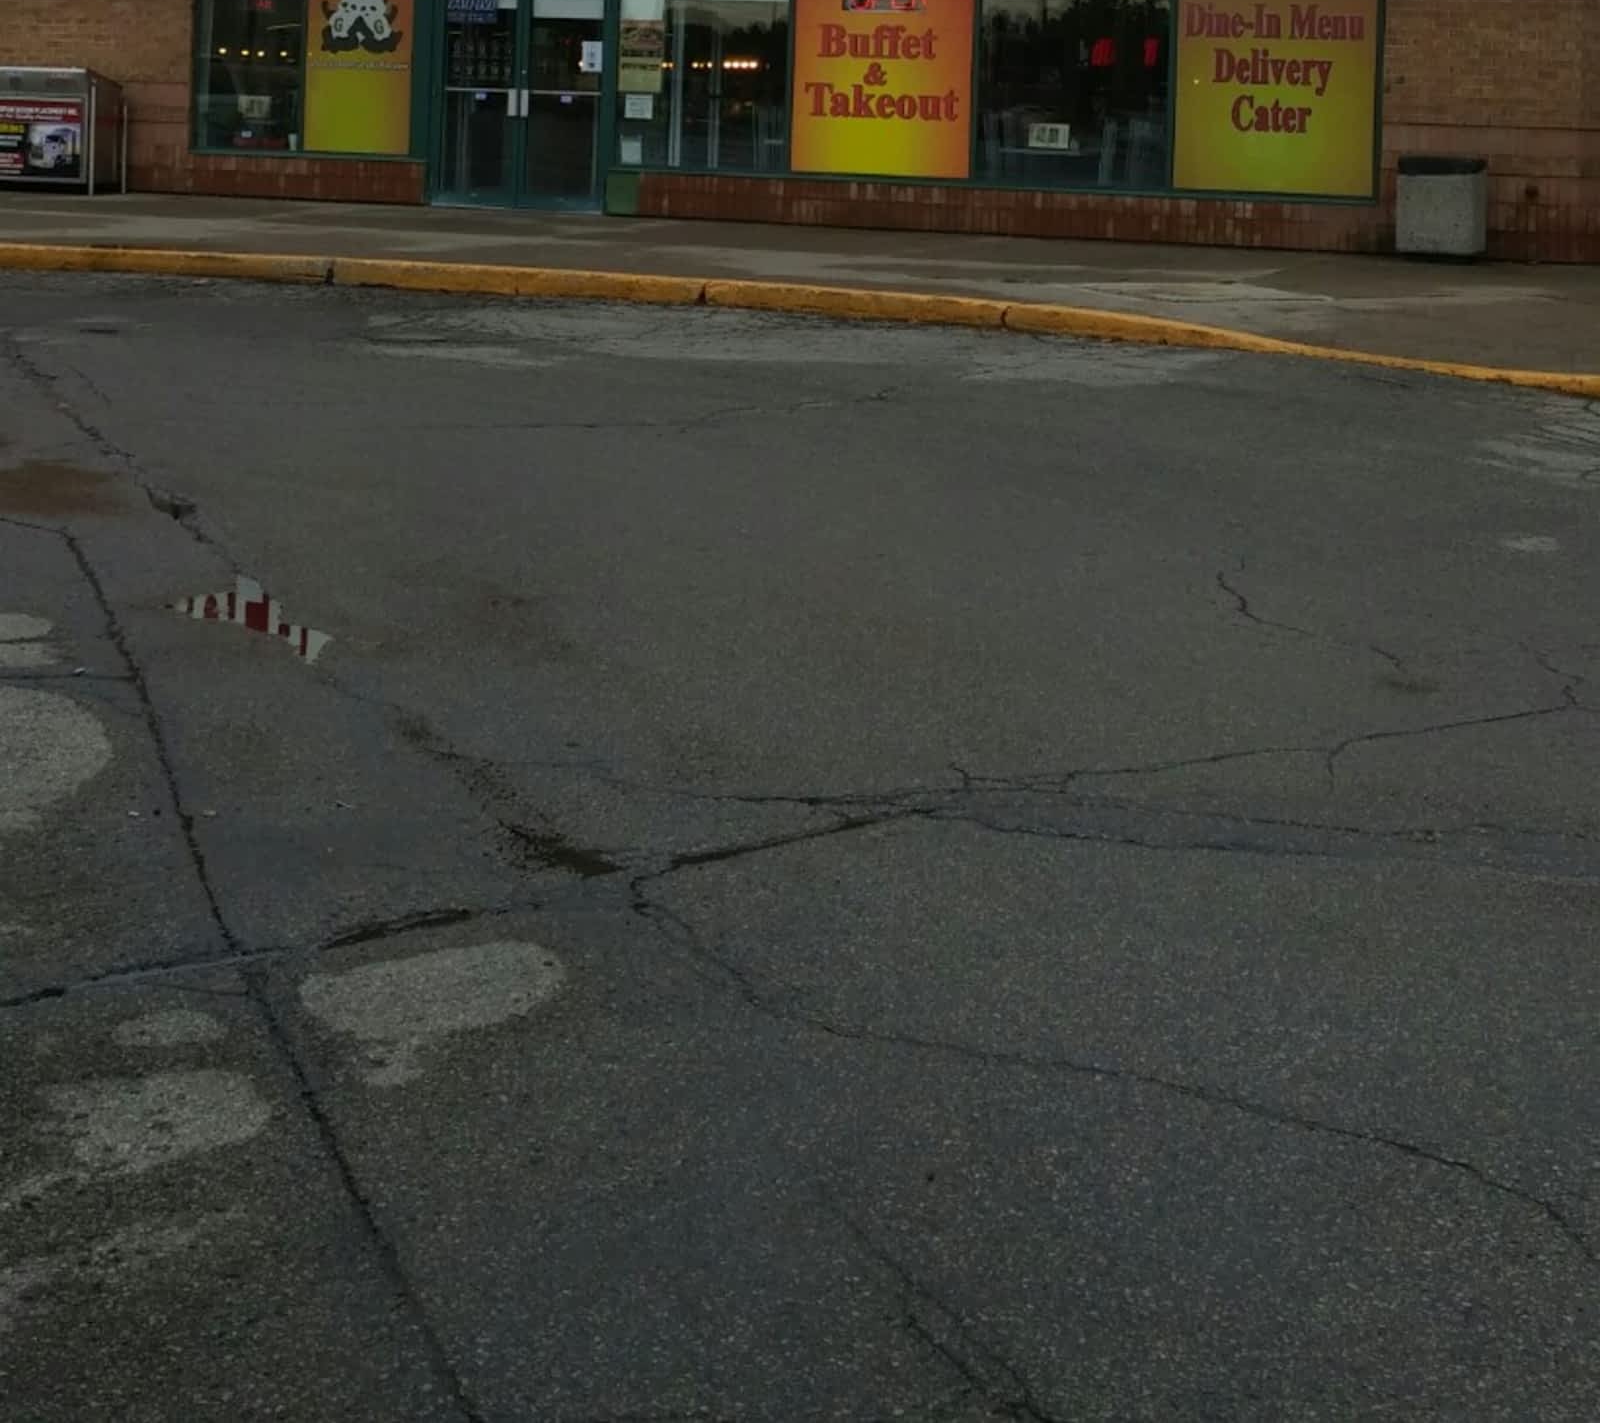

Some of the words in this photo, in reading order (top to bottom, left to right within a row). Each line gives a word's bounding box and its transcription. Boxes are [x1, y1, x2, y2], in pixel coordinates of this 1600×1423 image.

[334, 18, 344, 33] G
[374, 19, 385, 35] G
[1183, 2, 1281, 38] Dine-In
[1288, 3, 1365, 40] Menu
[817, 23, 938, 61] Buffet
[863, 61, 888, 86] &
[1212, 47, 1334, 97] Delivery
[804, 82, 959, 122] Takeout
[1231, 94, 1312, 134] Cater
